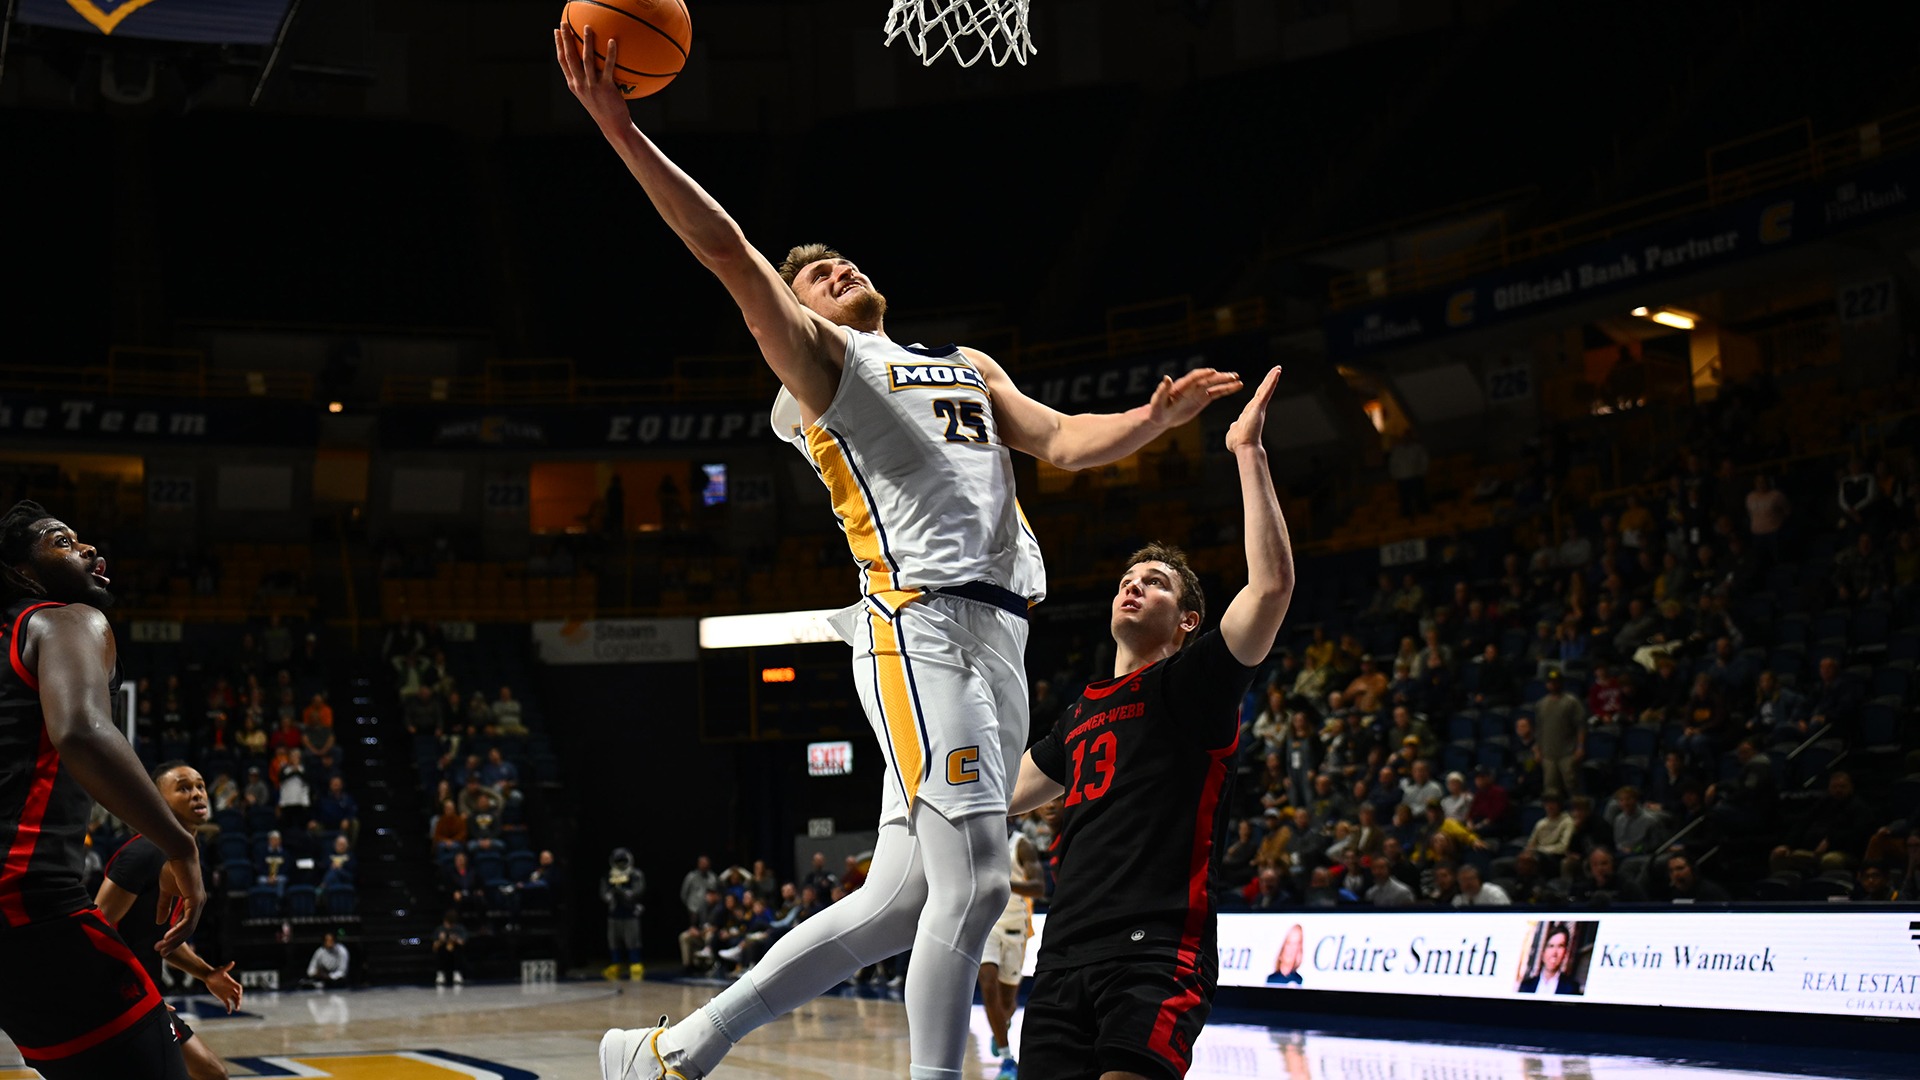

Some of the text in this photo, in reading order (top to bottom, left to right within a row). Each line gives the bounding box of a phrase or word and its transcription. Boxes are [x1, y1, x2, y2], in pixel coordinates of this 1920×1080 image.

[1492, 229, 1740, 311] Official Bank Partner
[1845, 280, 1889, 319] 227
[1019, 354, 1207, 404] UCCES
[932, 399, 990, 443] 25
[595, 622, 657, 640] Steam
[945, 745, 979, 786] C
[1064, 731, 1117, 808] 13
[1313, 935, 1397, 972] Claire
[1405, 936, 1498, 976] Smith
[1600, 944, 1662, 969] Kevin
[1673, 945, 1777, 973] Wamack
[1802, 971, 1850, 992] REAL
[1845, 998, 1920, 1012] CHATTAN
